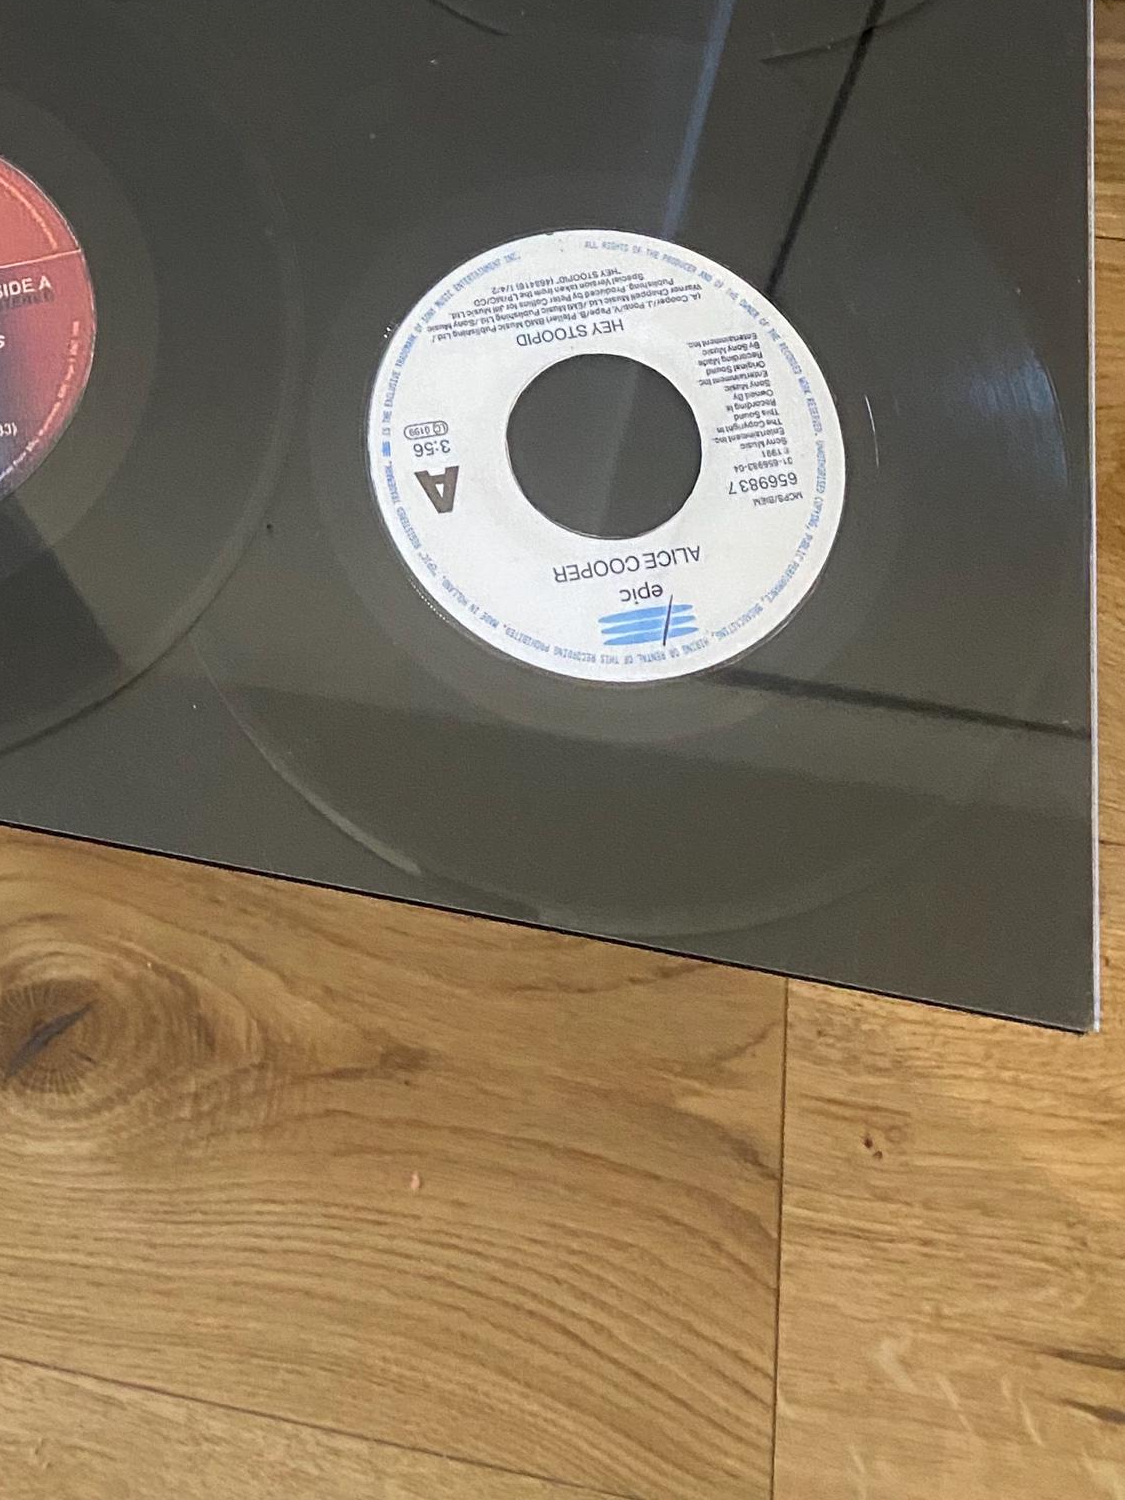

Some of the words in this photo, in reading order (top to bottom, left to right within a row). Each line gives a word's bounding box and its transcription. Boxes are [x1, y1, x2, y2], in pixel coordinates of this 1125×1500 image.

[610, 271, 644, 284] Special
[554, 284, 577, 293] taken
[579, 278, 610, 289] Version
[670, 283, 701, 294] Warner
[519, 291, 532, 299] the
[533, 288, 553, 296] from
[583, 285, 625, 298] Produced
[518, 297, 547, 308] Collins
[549, 294, 571, 303] Peter
[603, 295, 629, 304] Music
[466, 306, 491, 316] Music
[505, 302, 517, 310] for
[540, 304, 566, 314] Music
[494, 307, 539, 321] Publishing
[425, 322, 451, 332] Music
[452, 324, 496, 338] Publishing
[497, 321, 523, 331] Music
[589, 318, 623, 335] HEY
[515, 324, 587, 346] STOOPID
[701, 346, 726, 356] Music
[727, 342, 748, 352] Sony
[697, 357, 720, 366] Made
[720, 350, 762, 363] Recording
[705, 365, 732, 375] Sound
[733, 397, 776, 410] Recording
[733, 410, 760, 420] Sound
[408, 425, 430, 435] 0199
[739, 440, 764, 450] Music
[764, 436, 787, 446] Sony
[412, 439, 450, 457] 3:56
[737, 472, 797, 491] 656983
[412, 465, 465, 515] A
[752, 490, 802, 505] MCPS/BIEM
[642, 545, 701, 569] ALICE
[552, 554, 640, 583] COOPER
[617, 581, 664, 605] epic
